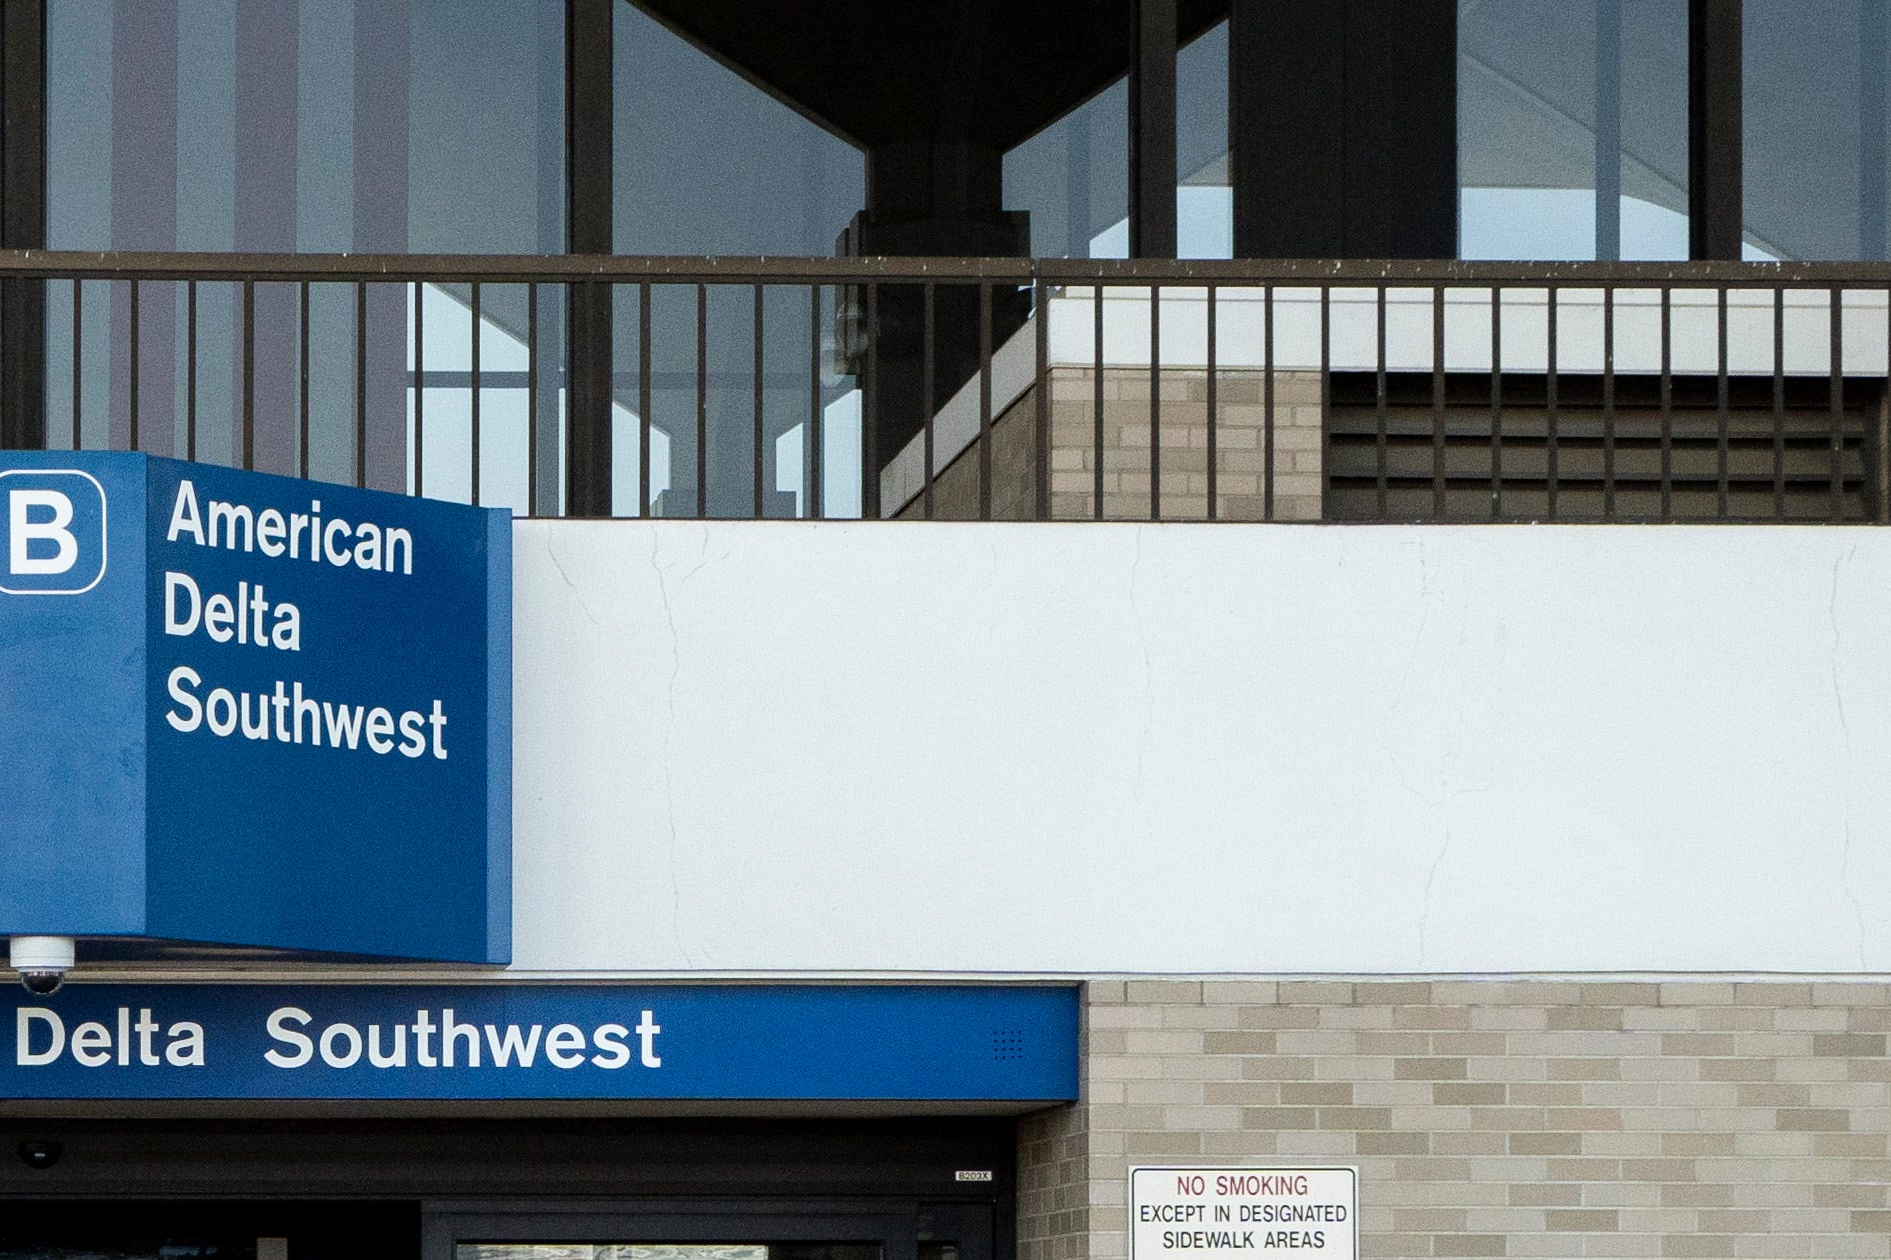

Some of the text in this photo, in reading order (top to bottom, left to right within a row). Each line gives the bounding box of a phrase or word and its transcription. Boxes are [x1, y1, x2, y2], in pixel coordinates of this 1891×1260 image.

[8, 488, 78, 576] B
[168, 479, 413, 575] American
[165, 569, 302, 652] Delta
[166, 665, 448, 760] Southwest
[17, 1006, 206, 1067] Delta
[264, 1006, 662, 1067] Southwest
[958, 1172, 989, 1180] B203X
[1177, 1176, 1308, 1195] NO SMOKING
[1140, 1205, 1347, 1222] EXCEPT IN DESIGNATED
[1163, 1231, 1325, 1249] SIDEWALK AREAS
